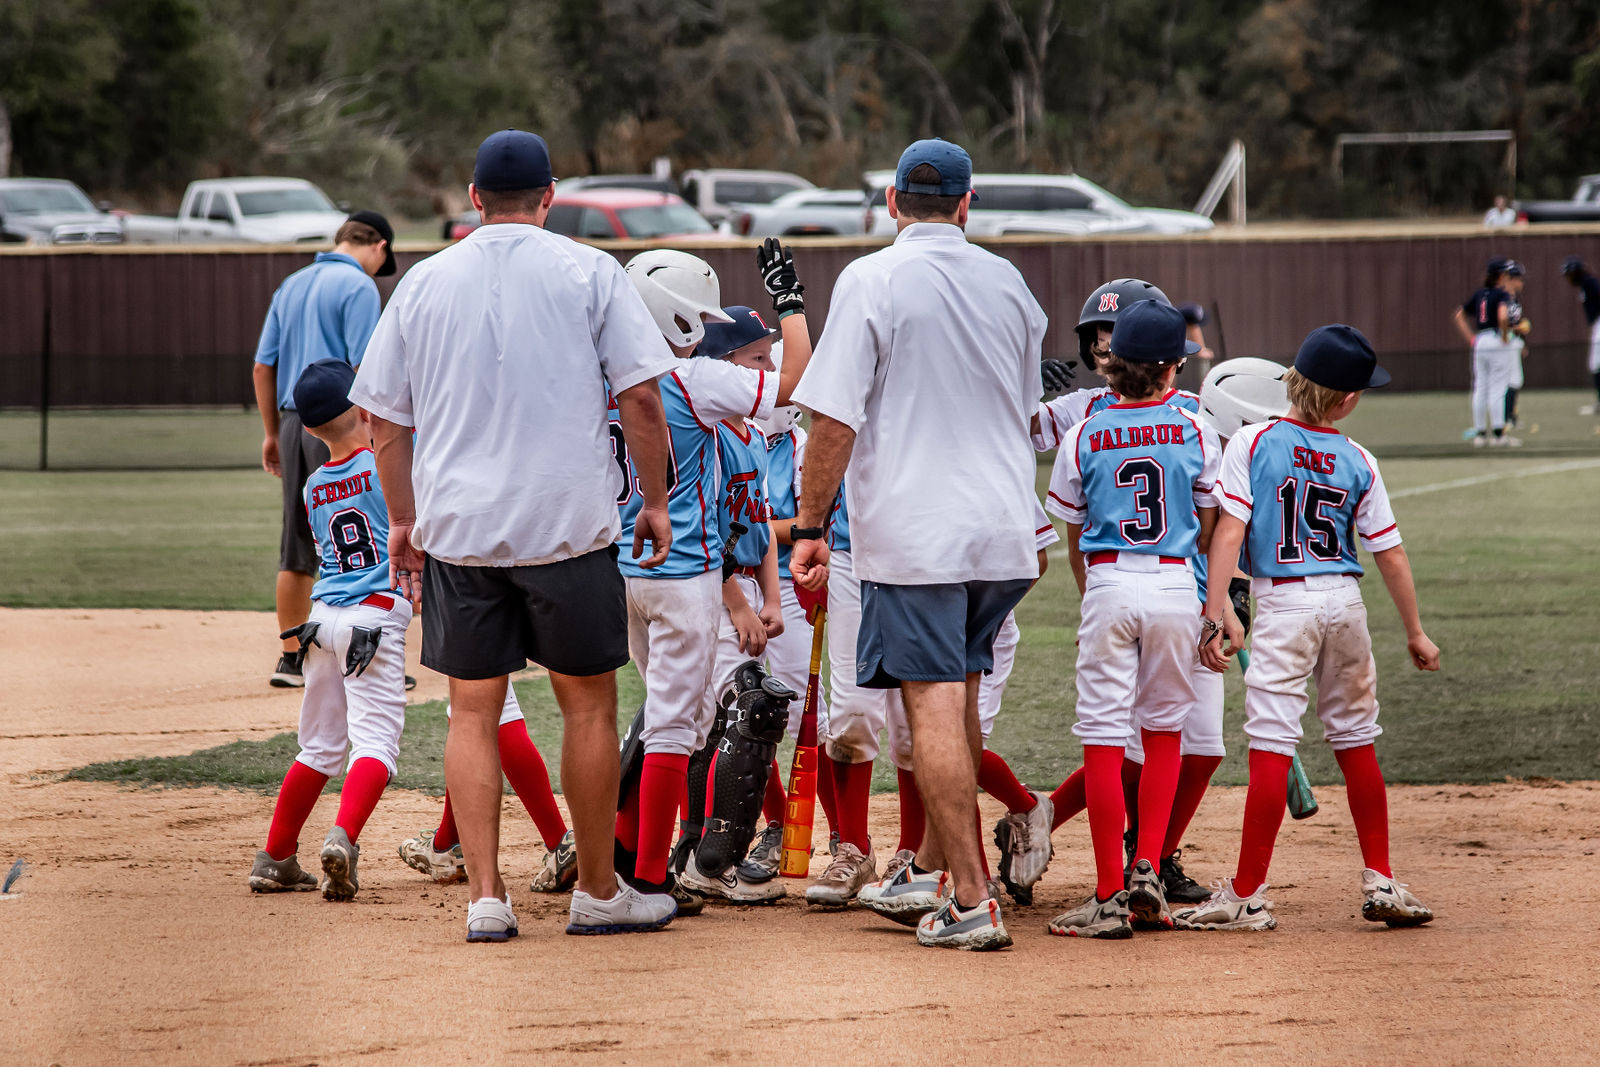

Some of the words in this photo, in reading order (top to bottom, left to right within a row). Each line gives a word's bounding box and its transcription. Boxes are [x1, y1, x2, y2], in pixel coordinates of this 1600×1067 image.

[1089, 424, 1185, 453] WALDRUM
[1294, 446, 1336, 475] SIMS
[312, 470, 372, 509] SCHMIDT
[1115, 456, 1168, 546] 3
[329, 507, 381, 574] 8
[1276, 476, 1349, 564] 15
